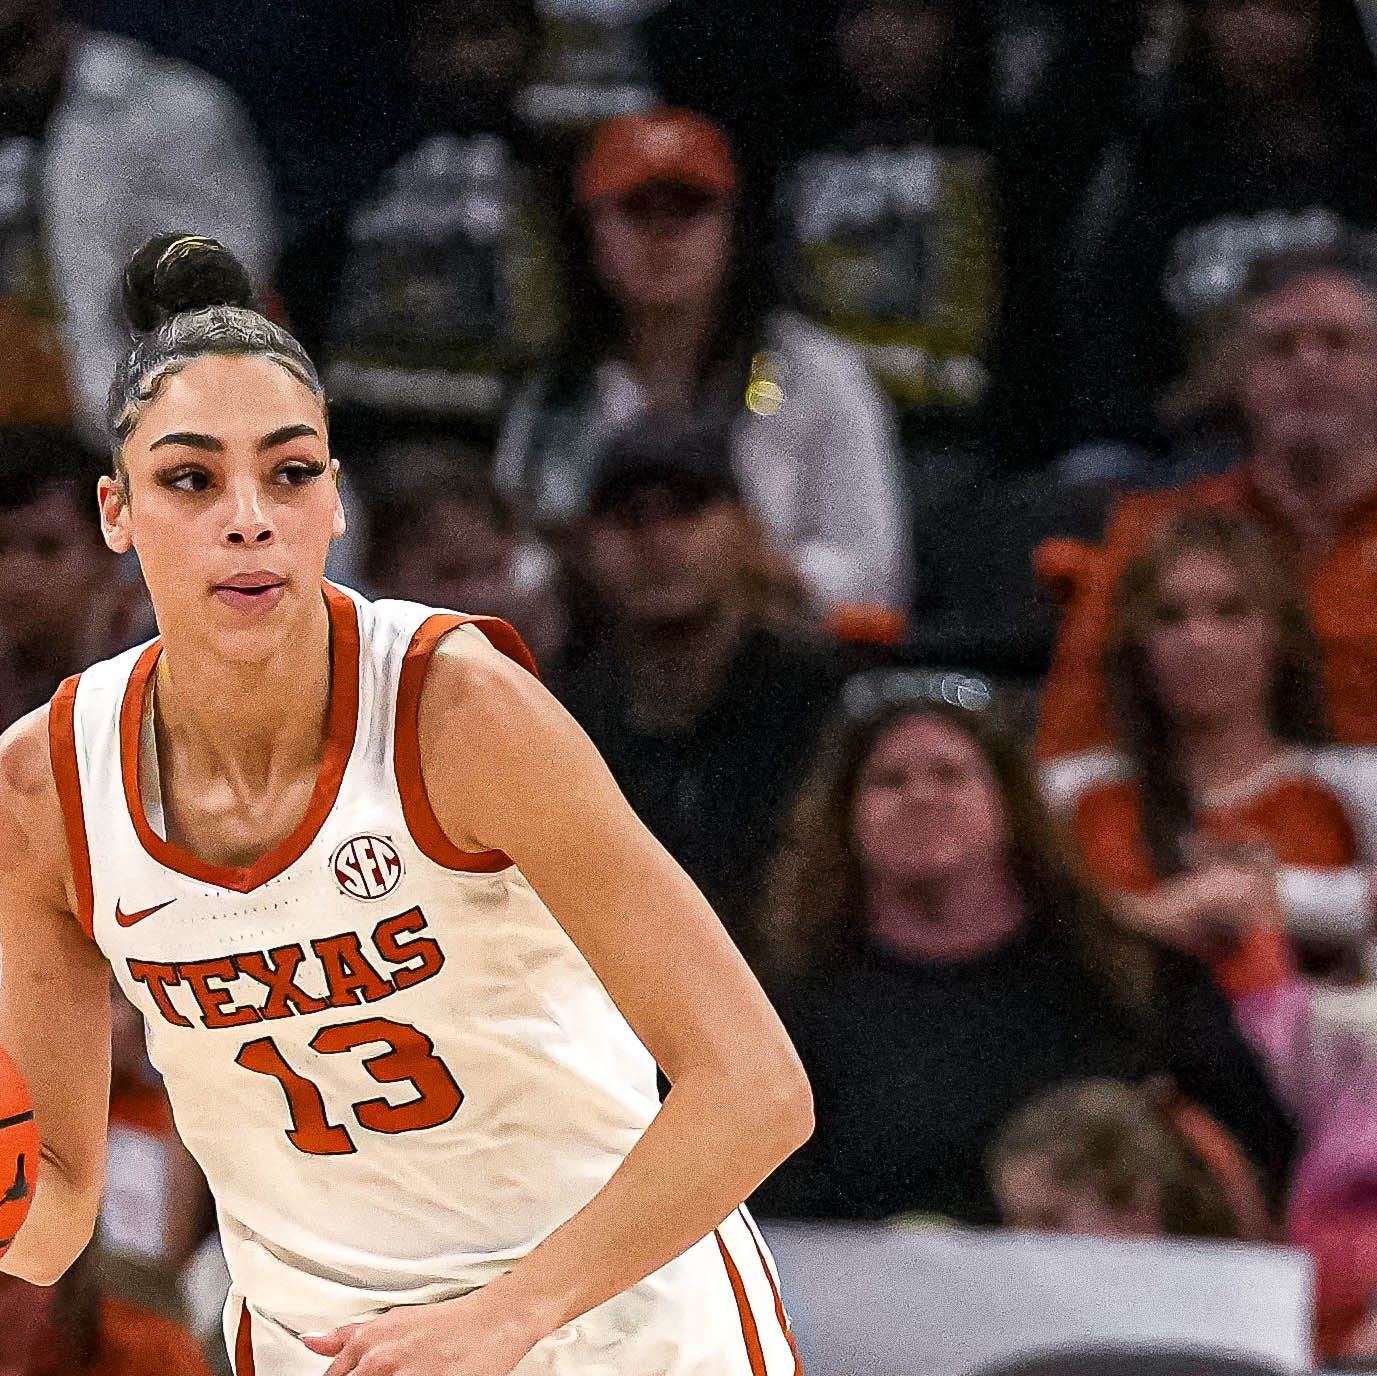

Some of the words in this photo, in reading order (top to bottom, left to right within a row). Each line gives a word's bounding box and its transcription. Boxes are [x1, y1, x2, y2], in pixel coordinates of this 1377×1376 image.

[335, 837, 401, 898] SEC
[126, 905, 445, 1028] TEXAS
[234, 1016, 464, 1155] 13
